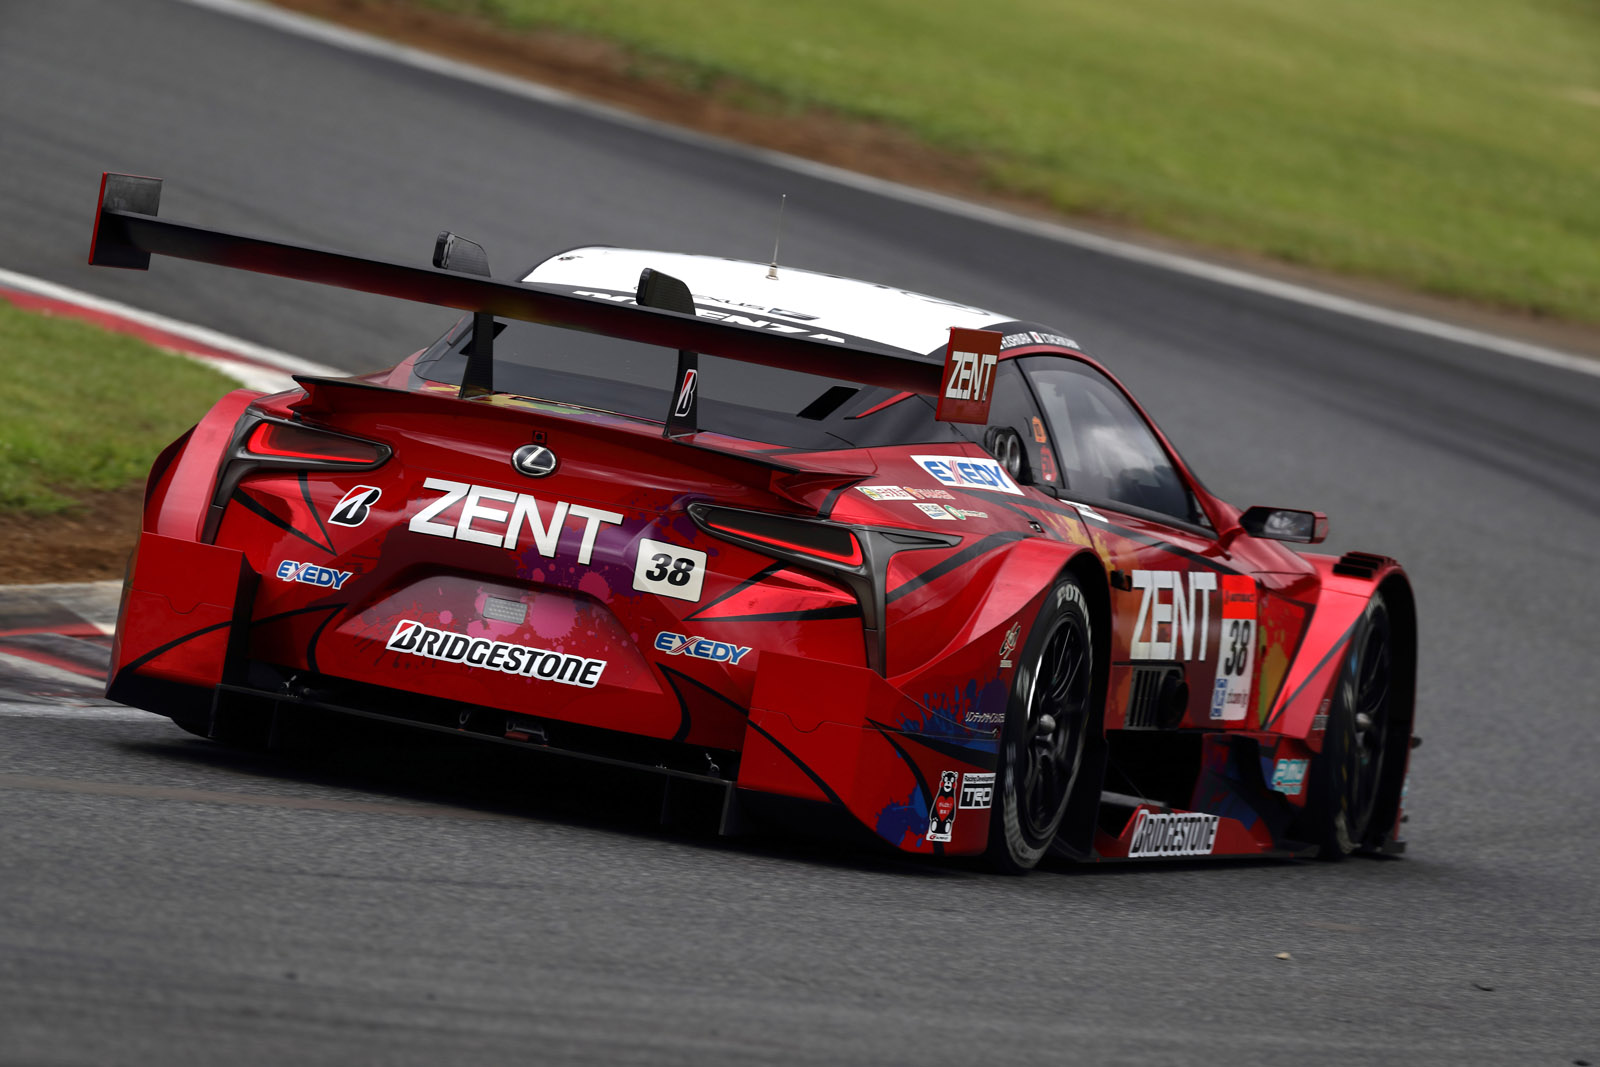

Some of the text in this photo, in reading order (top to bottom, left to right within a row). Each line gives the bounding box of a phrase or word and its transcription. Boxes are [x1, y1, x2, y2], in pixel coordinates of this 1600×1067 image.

[945, 351, 998, 402] ZENT
[923, 460, 1010, 489] EXEDY
[408, 478, 623, 565] ZENT
[276, 559, 353, 590] EXEDY
[645, 552, 693, 587] 38
[1129, 569, 1218, 662] ZENT
[388, 620, 606, 686] BRIDGESTONE
[655, 631, 752, 665] EXEDY
[1224, 619, 1251, 677] 38
[963, 787, 992, 808] TRD
[1130, 811, 1218, 855] BRIDGESTONE
